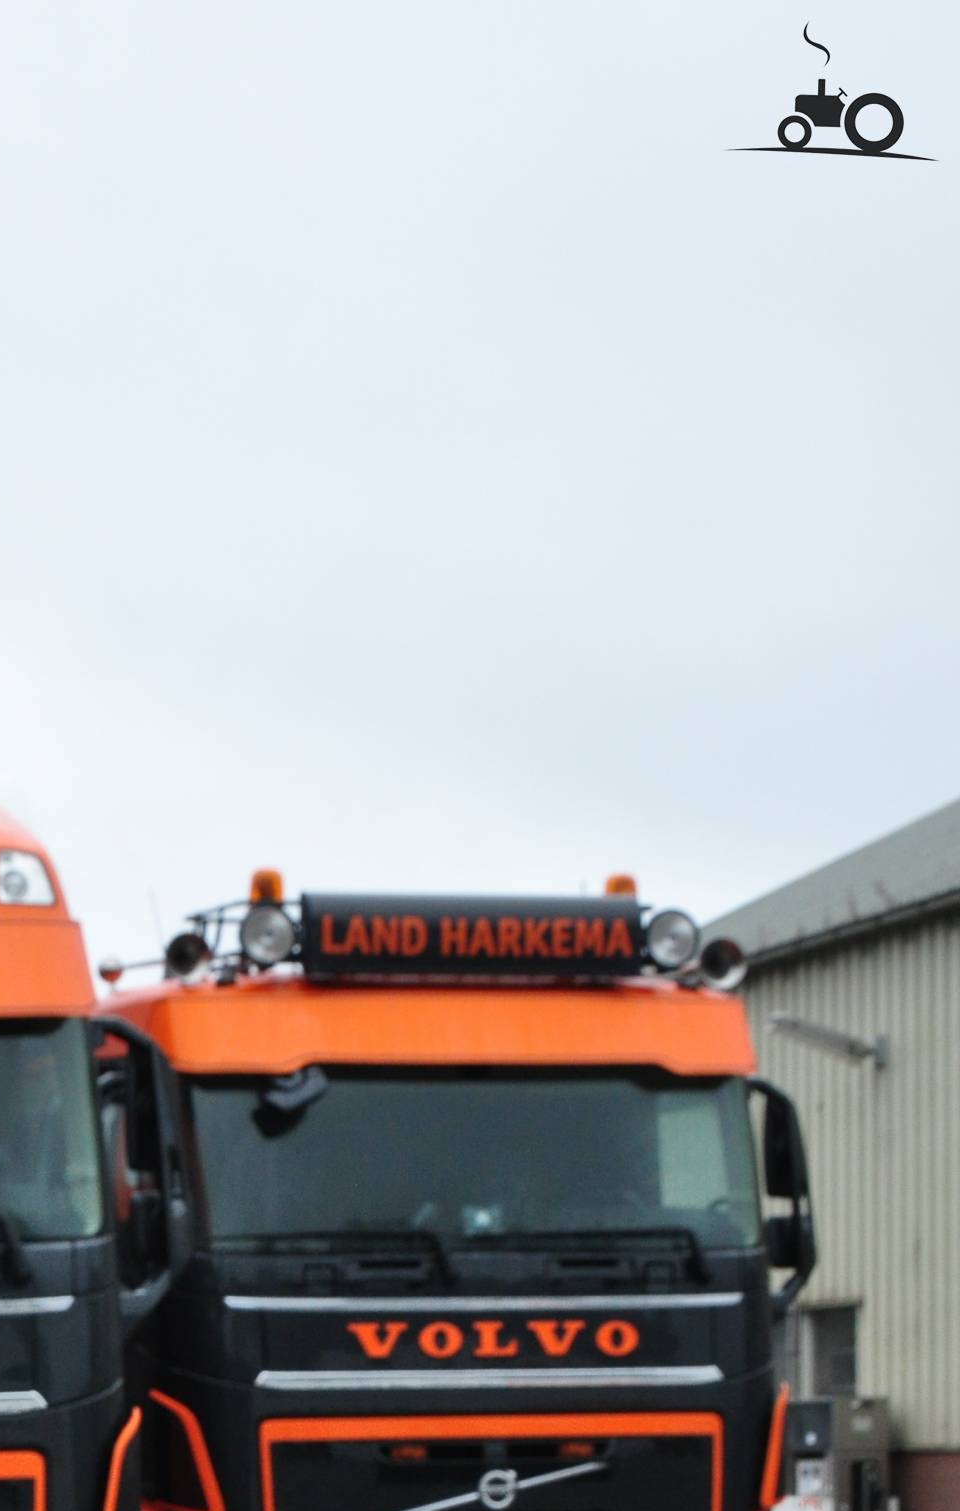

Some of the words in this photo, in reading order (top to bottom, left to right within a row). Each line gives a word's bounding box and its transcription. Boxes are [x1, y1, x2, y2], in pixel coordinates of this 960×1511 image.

[320, 913, 428, 956] LAND
[440, 914, 634, 958] HARKEMA
[346, 1319, 640, 1359] VOLVO
